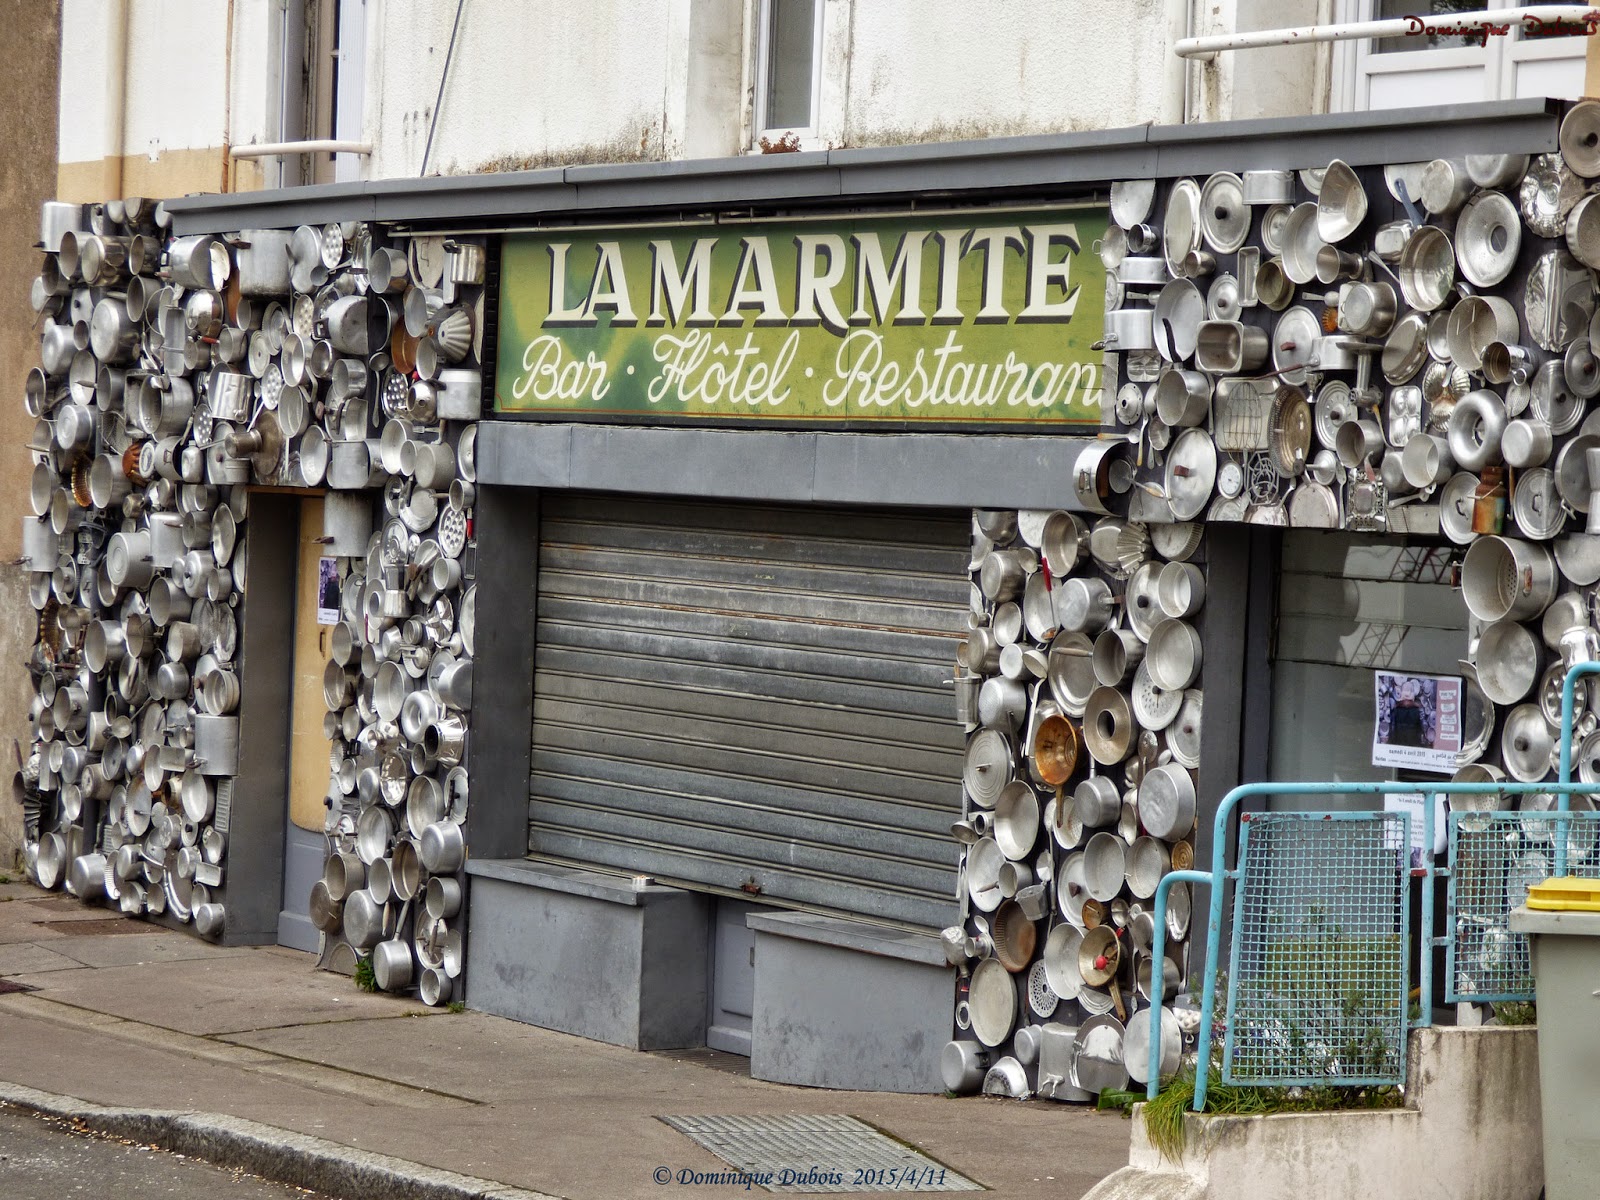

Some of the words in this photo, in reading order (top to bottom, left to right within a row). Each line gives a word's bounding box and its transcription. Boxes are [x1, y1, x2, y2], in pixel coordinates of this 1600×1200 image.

[512, 335, 610, 400] Bar
[647, 328, 799, 405] Hôtel
[823, 329, 1102, 407] Restauran
